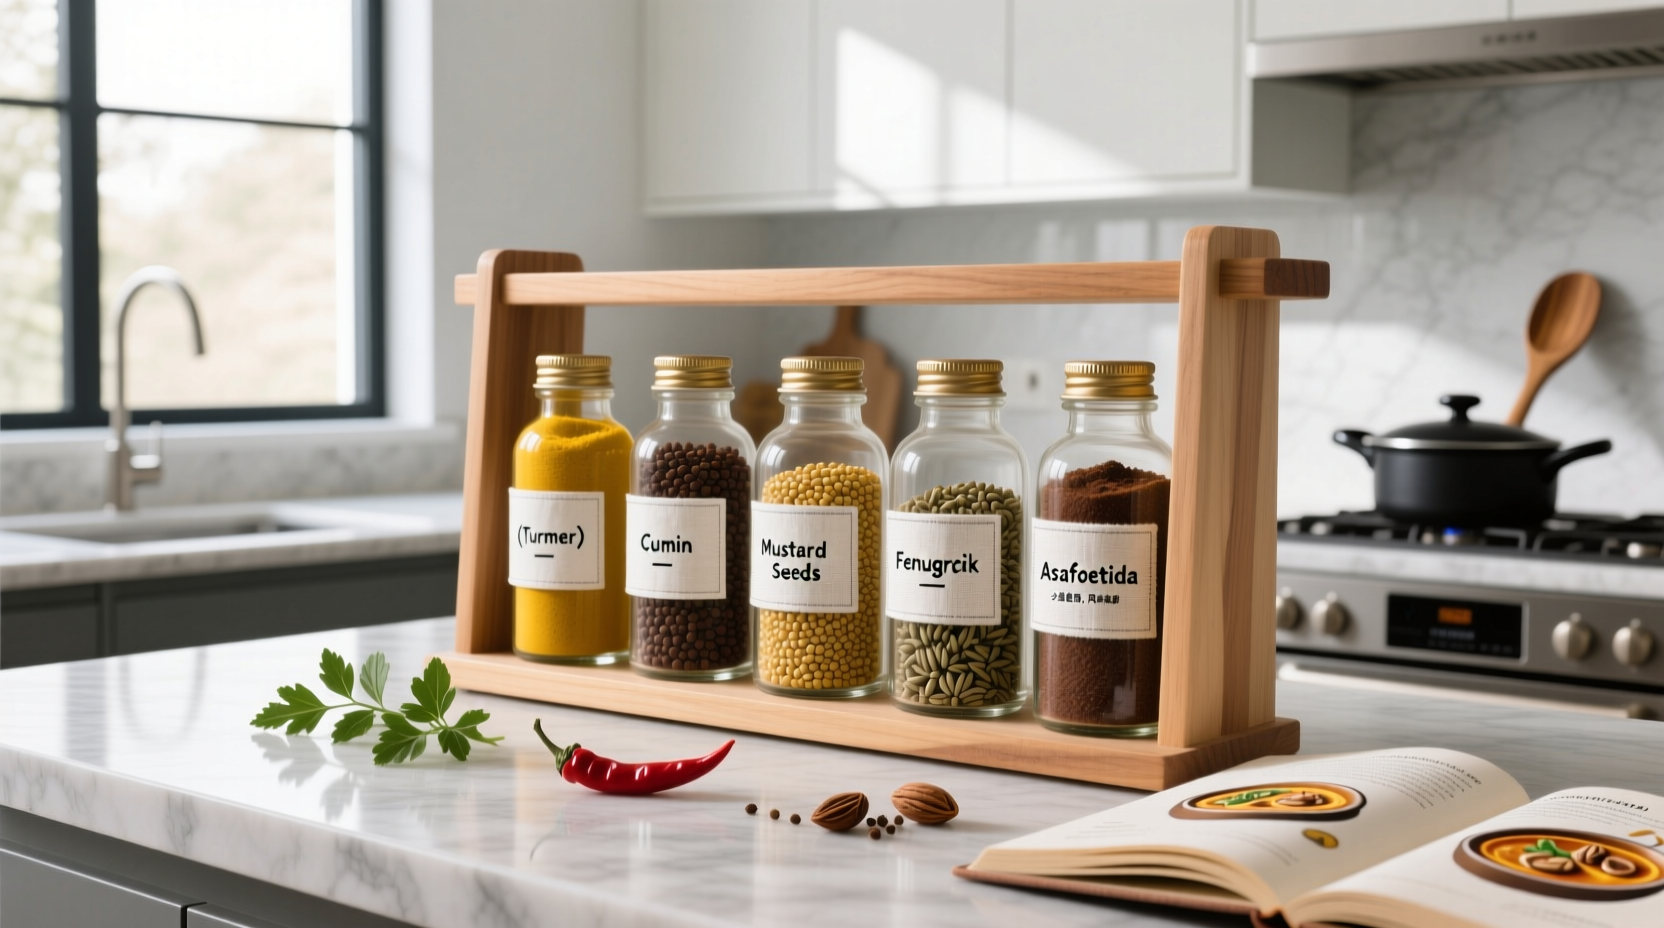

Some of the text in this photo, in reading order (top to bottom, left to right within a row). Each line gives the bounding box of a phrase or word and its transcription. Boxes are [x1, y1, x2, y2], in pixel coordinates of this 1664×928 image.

[517, 524, 584, 549] (Turmer)
[640, 533, 692, 553] Cumin
[761, 538, 826, 558] Mustard
[772, 562, 820, 581] Seeds
[1040, 562, 1138, 584] Asafoetida
